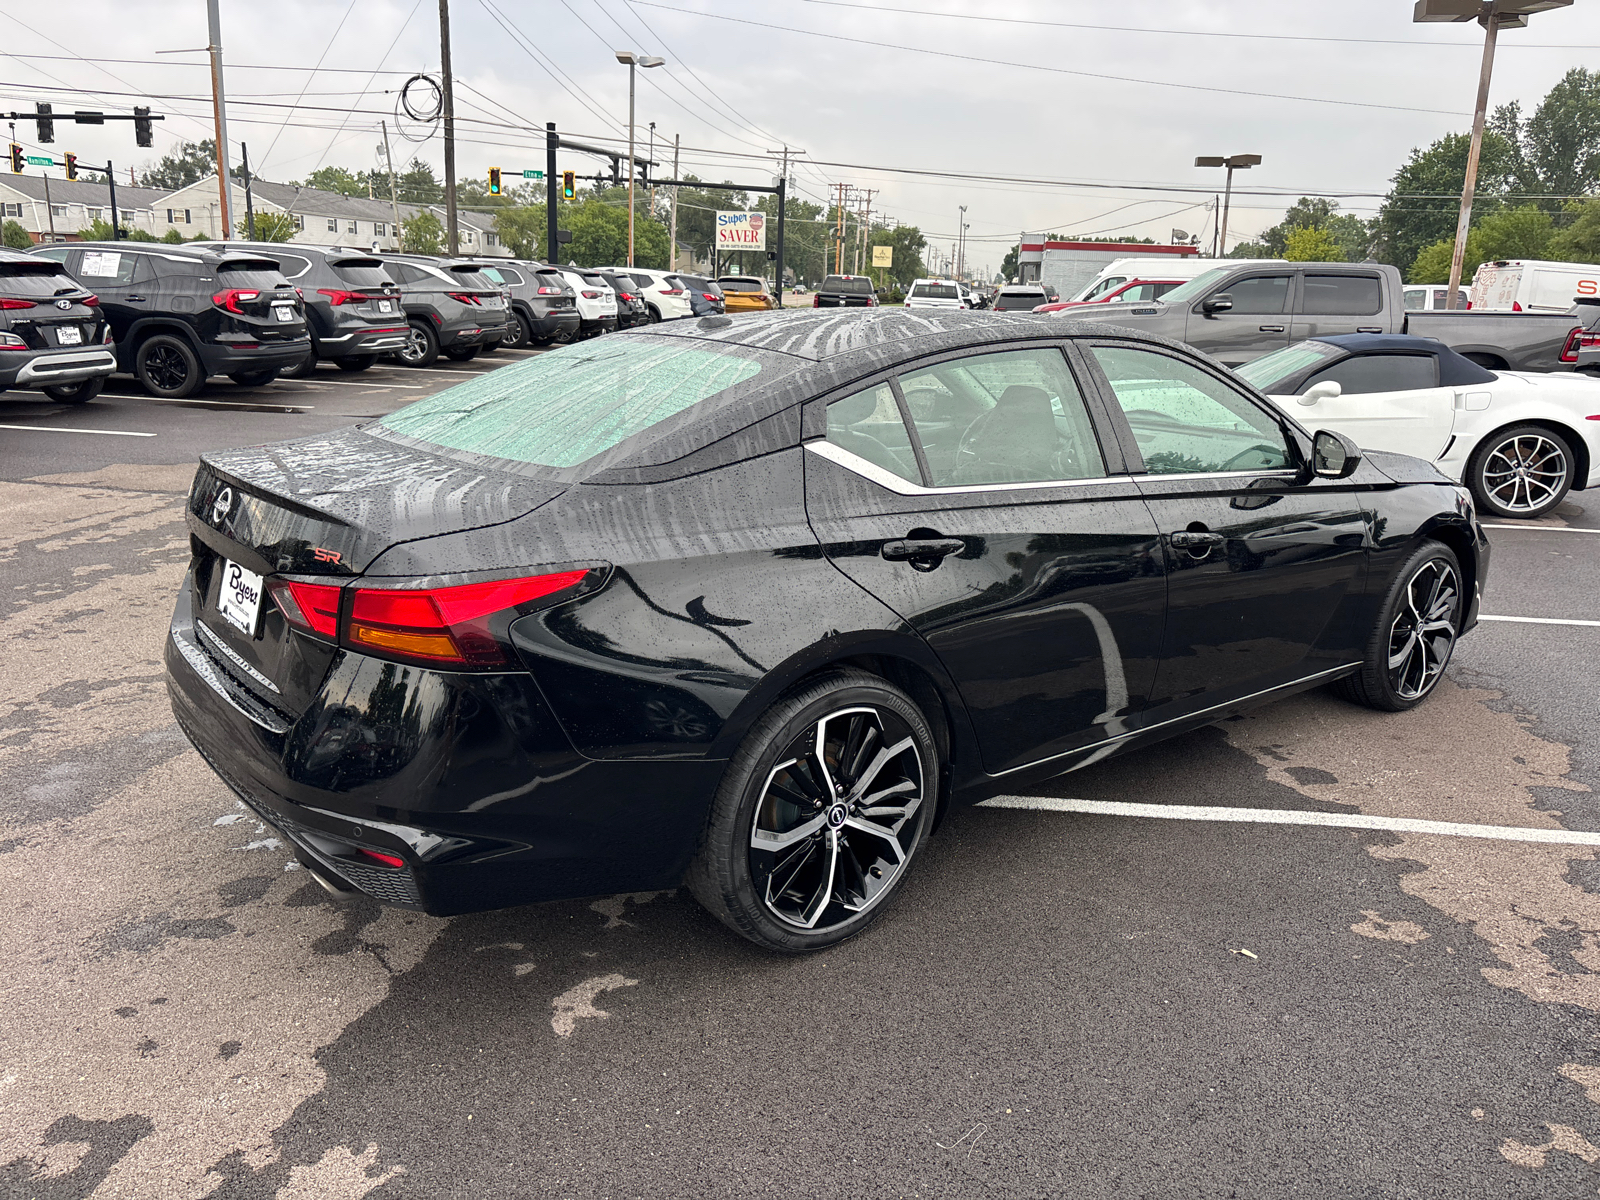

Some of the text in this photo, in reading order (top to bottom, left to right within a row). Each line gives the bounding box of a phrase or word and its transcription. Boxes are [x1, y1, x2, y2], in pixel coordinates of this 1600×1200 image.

[718, 213, 747, 226] Super
[719, 229, 759, 243] SAVER
[314, 548, 341, 565] SR
[229, 563, 258, 606] Byers
